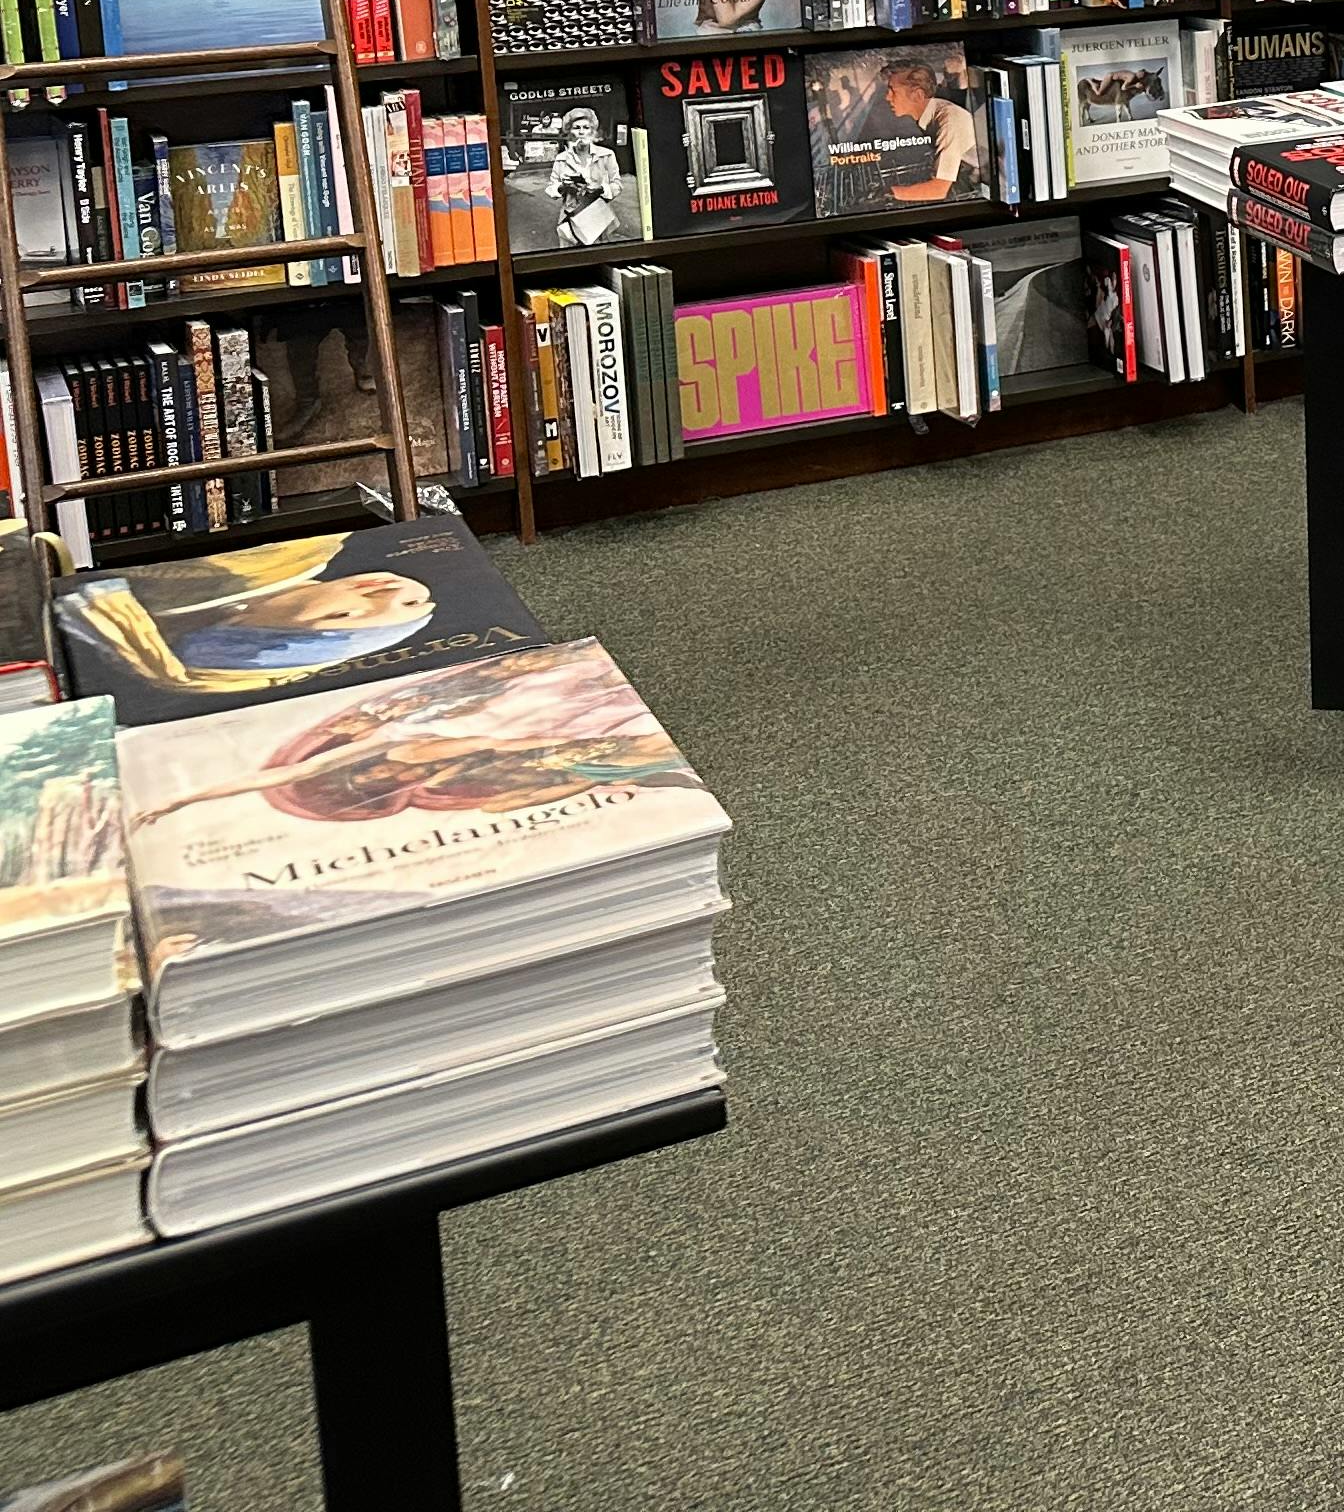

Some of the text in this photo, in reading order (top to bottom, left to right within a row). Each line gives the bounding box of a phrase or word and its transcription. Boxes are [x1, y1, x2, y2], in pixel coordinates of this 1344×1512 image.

[1070, 32, 1172, 54] JUERGEN TELLER
[660, 54, 787, 98] SAVED
[509, 84, 612, 102] GODLIS STREETS
[828, 134, 933, 156] William Eggleston
[830, 150, 883, 166] Portraits
[1245, 160, 1311, 201] SOLED OUT
[690, 192, 780, 214] BY DIANE KEATON
[595, 301, 622, 414] MOROZOV
[675, 294, 860, 431] SPIKE
[242, 786, 639, 892] Michelangelo
